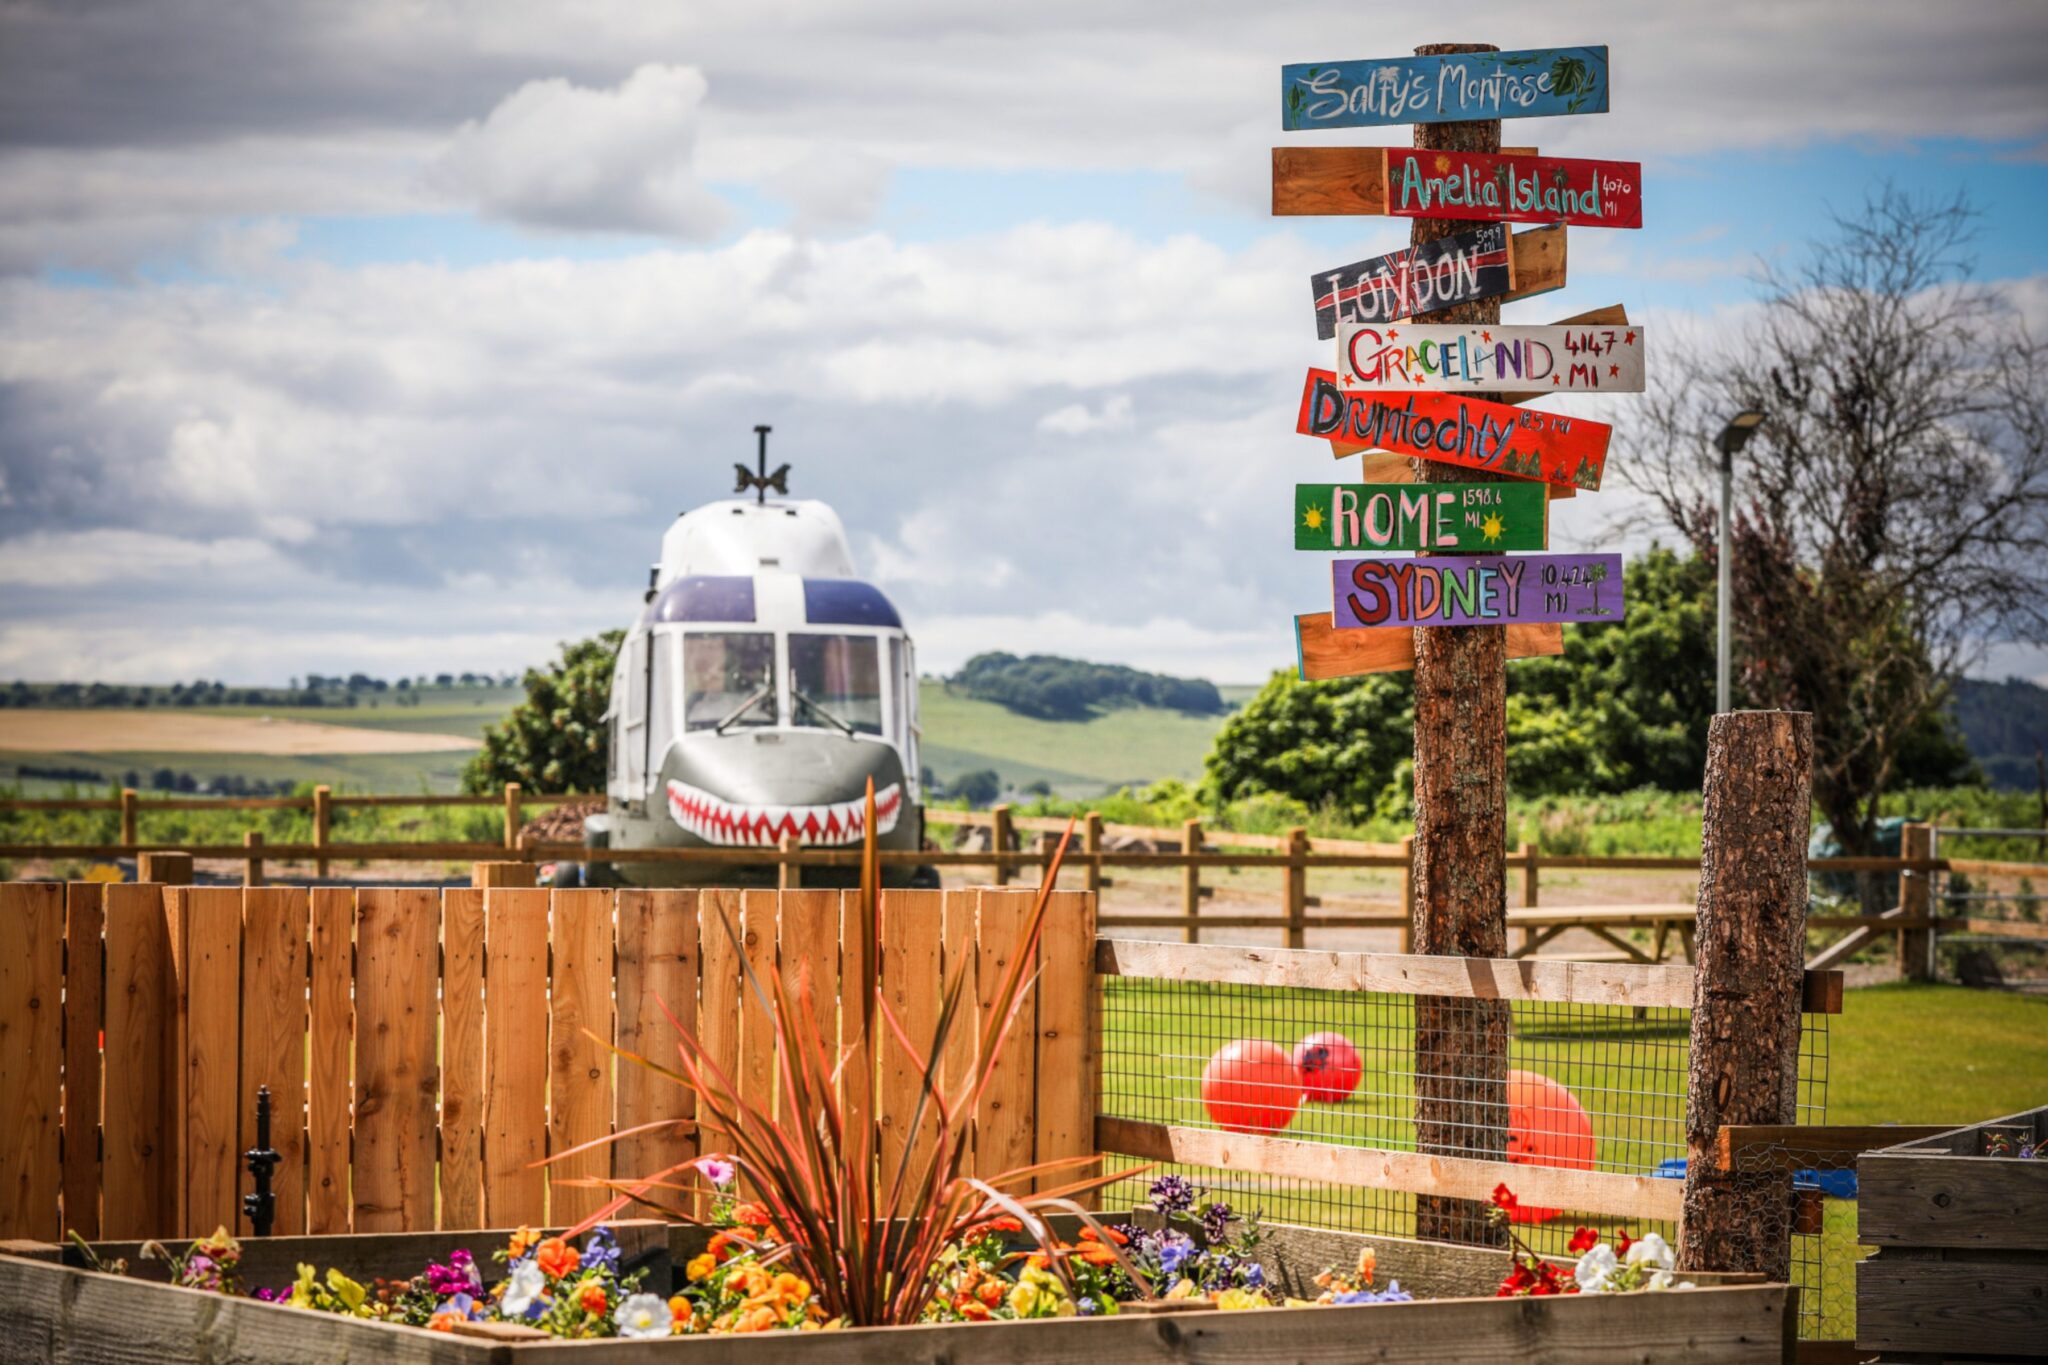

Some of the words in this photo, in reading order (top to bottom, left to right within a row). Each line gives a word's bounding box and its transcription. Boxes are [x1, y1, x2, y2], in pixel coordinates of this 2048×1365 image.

[1296, 66, 1433, 120] Salty's
[1437, 63, 1557, 114] Montrose
[1401, 156, 1499, 211] Amelia
[1508, 162, 1604, 218] Island
[1602, 174, 1632, 197] 4070
[1604, 200, 1618, 217] MI
[1327, 243, 1481, 323] LONDON
[1348, 328, 1554, 385] GRACELAND
[1565, 330, 1618, 358] 4147
[1568, 363, 1600, 388] MI
[1307, 376, 1515, 467] Drumtochty
[1462, 488, 1502, 508] 1598.6
[1331, 486, 1459, 548] ROME
[1465, 511, 1480, 528] MI
[1540, 563, 1593, 589] 10,424
[1347, 560, 1525, 626] SYDNEY
[1544, 592, 1568, 614] MI
